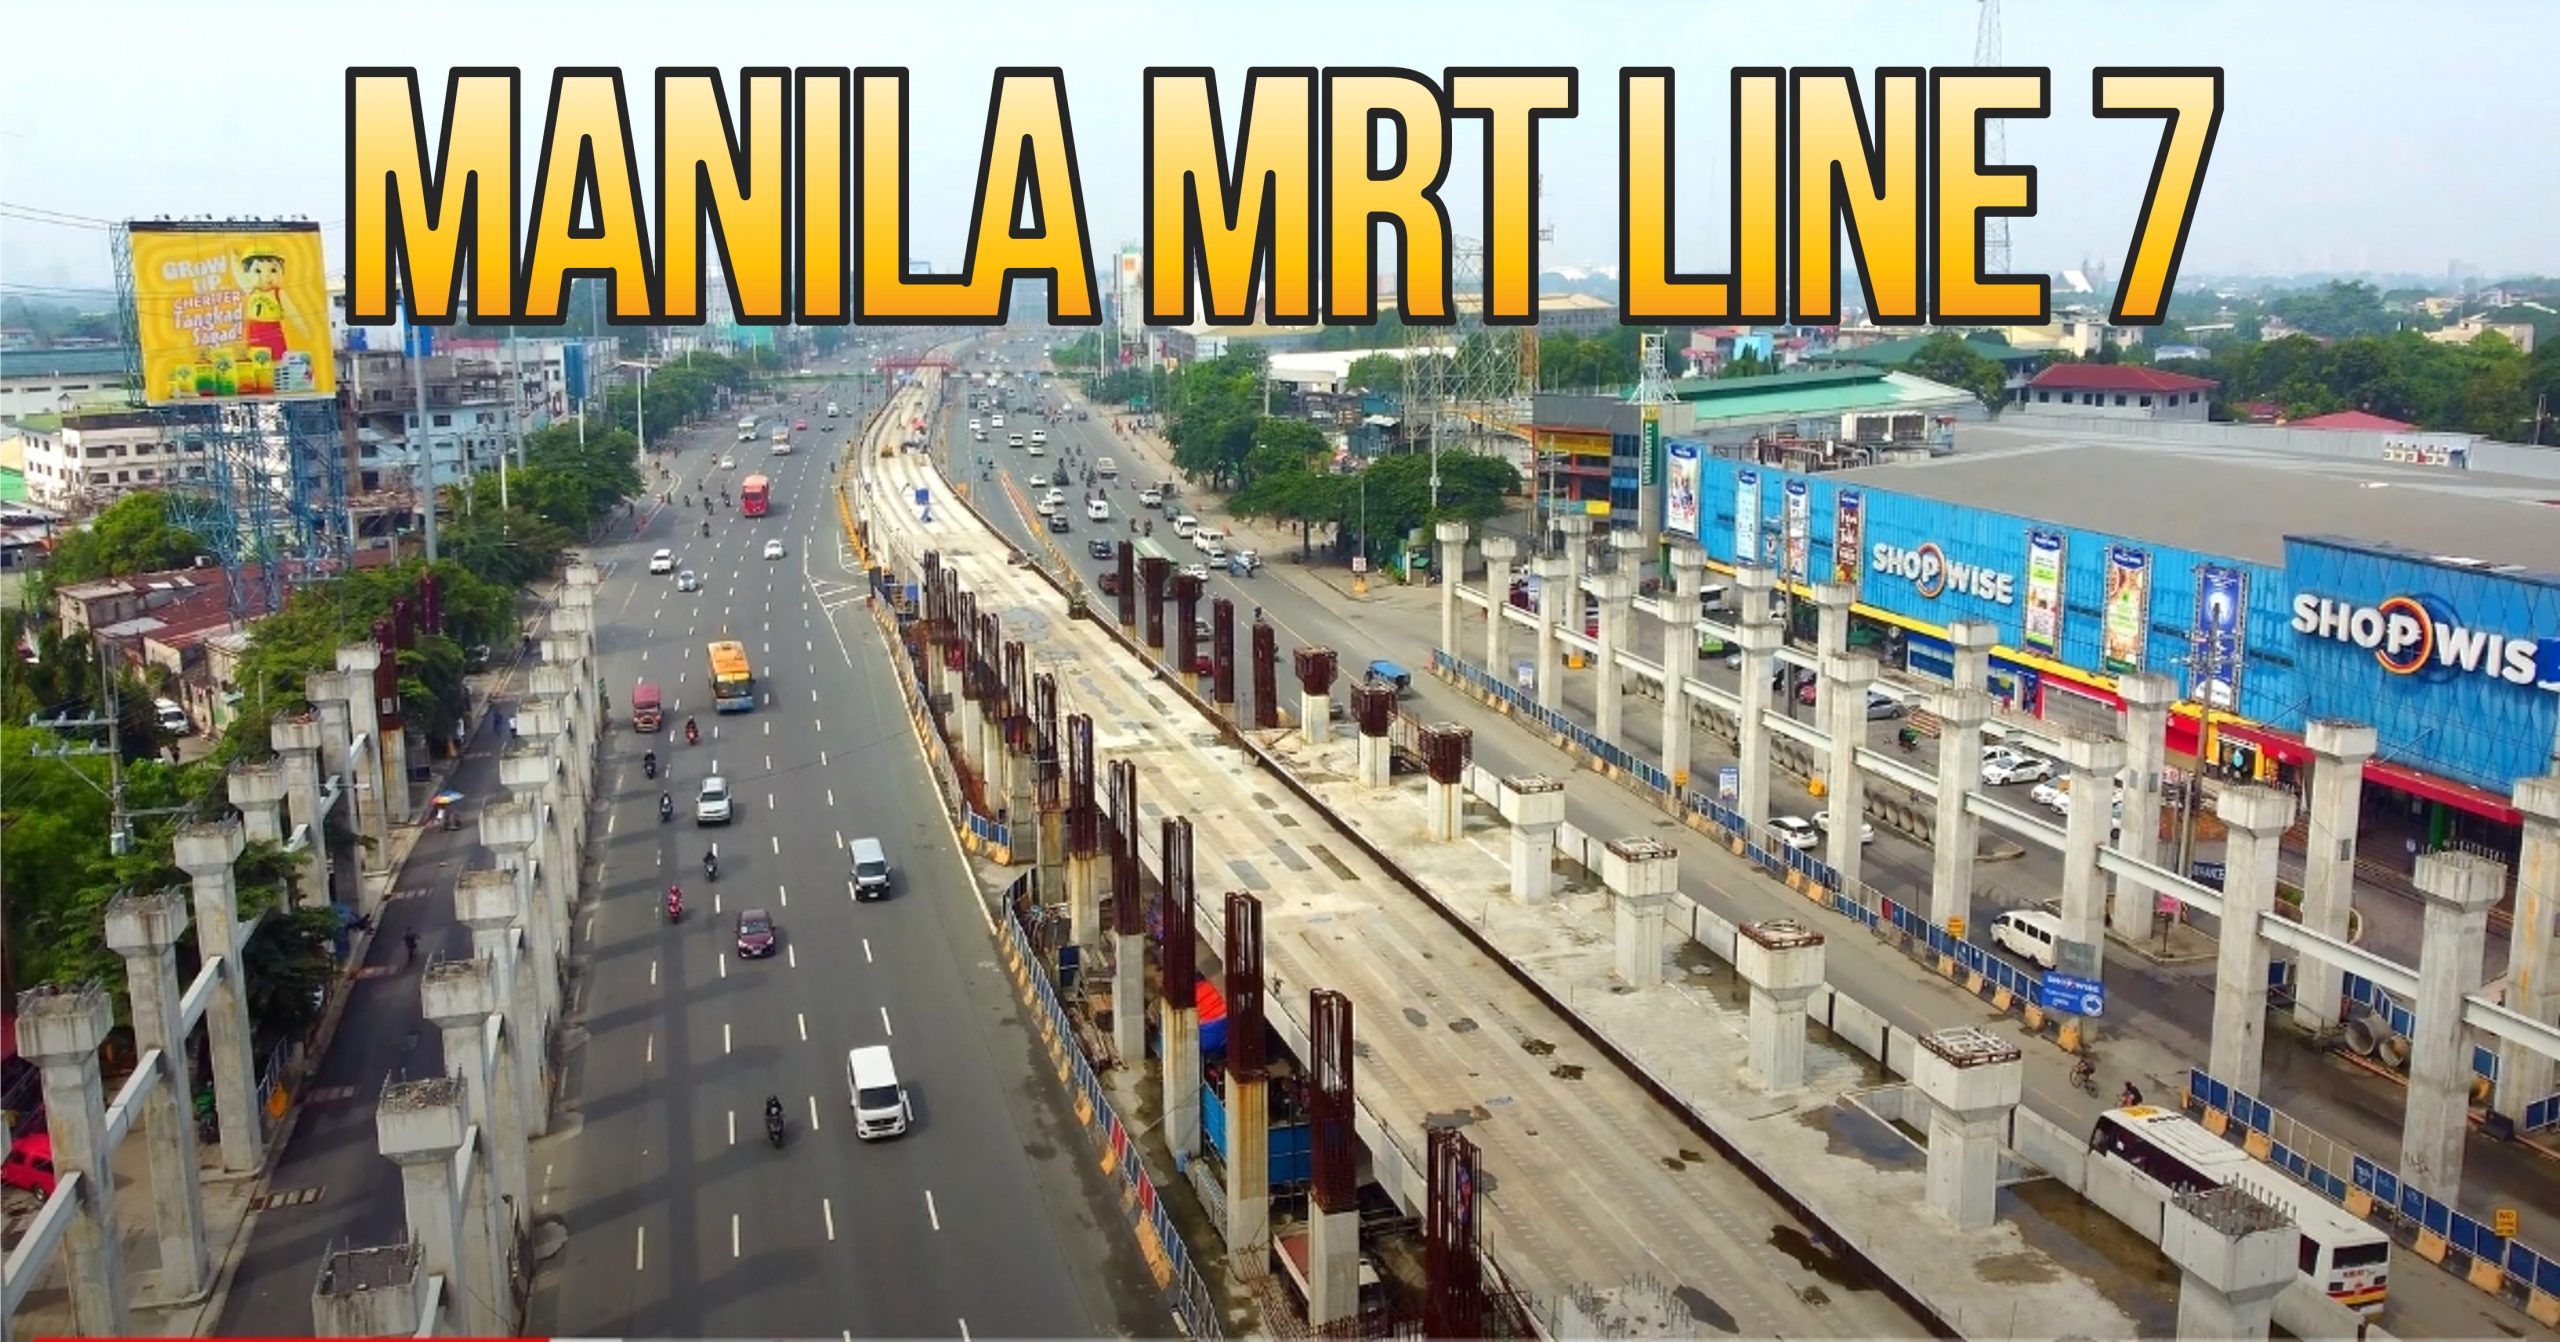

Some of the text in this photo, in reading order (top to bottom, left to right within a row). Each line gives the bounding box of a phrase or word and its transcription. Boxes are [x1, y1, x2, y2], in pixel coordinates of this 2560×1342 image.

[194, 274, 220, 293] UP
[174, 303, 242, 330] Tangkad
[2291, 593, 2560, 690] SHOPWIS
